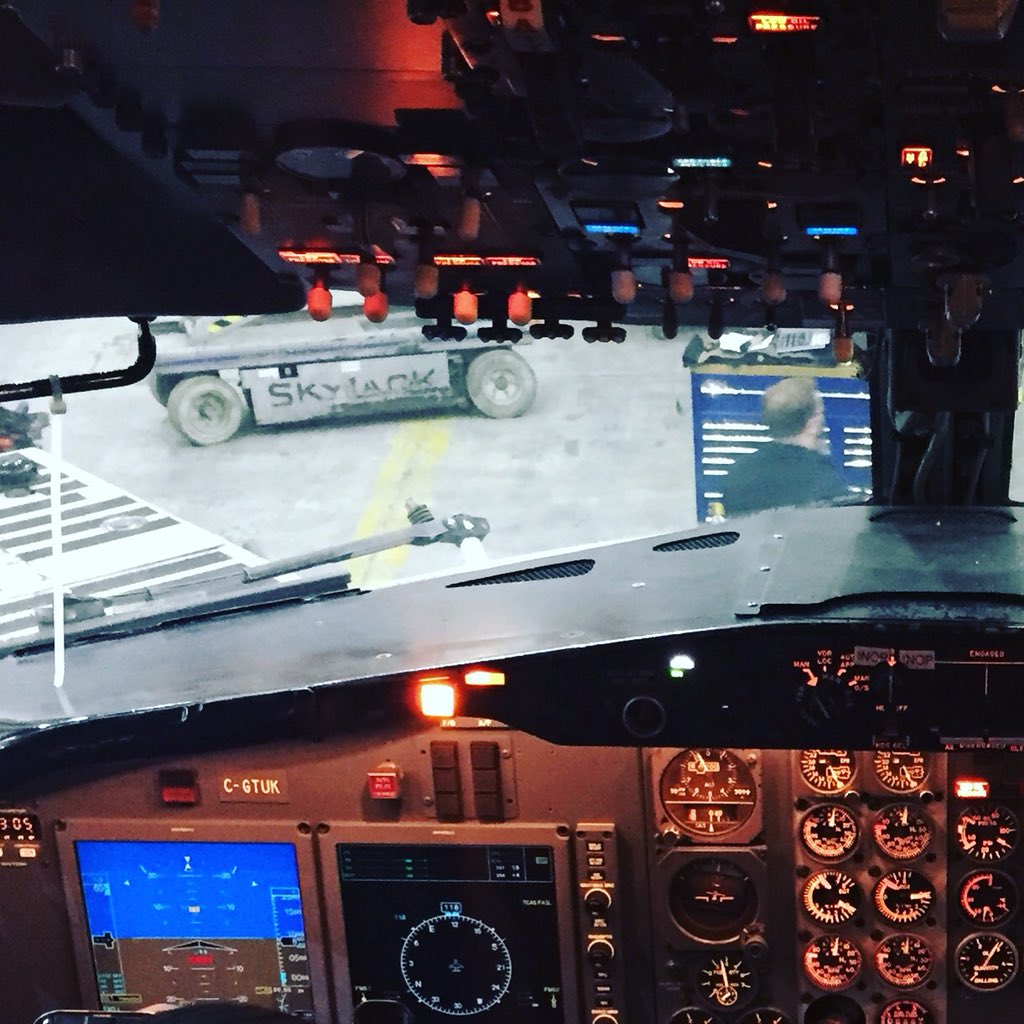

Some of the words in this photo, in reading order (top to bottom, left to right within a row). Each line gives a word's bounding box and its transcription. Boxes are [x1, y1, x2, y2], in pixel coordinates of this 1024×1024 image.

[858, 651, 887, 663] INOP
[902, 654, 934, 666] INOP
[222, 778, 280, 794] C-GTUK
